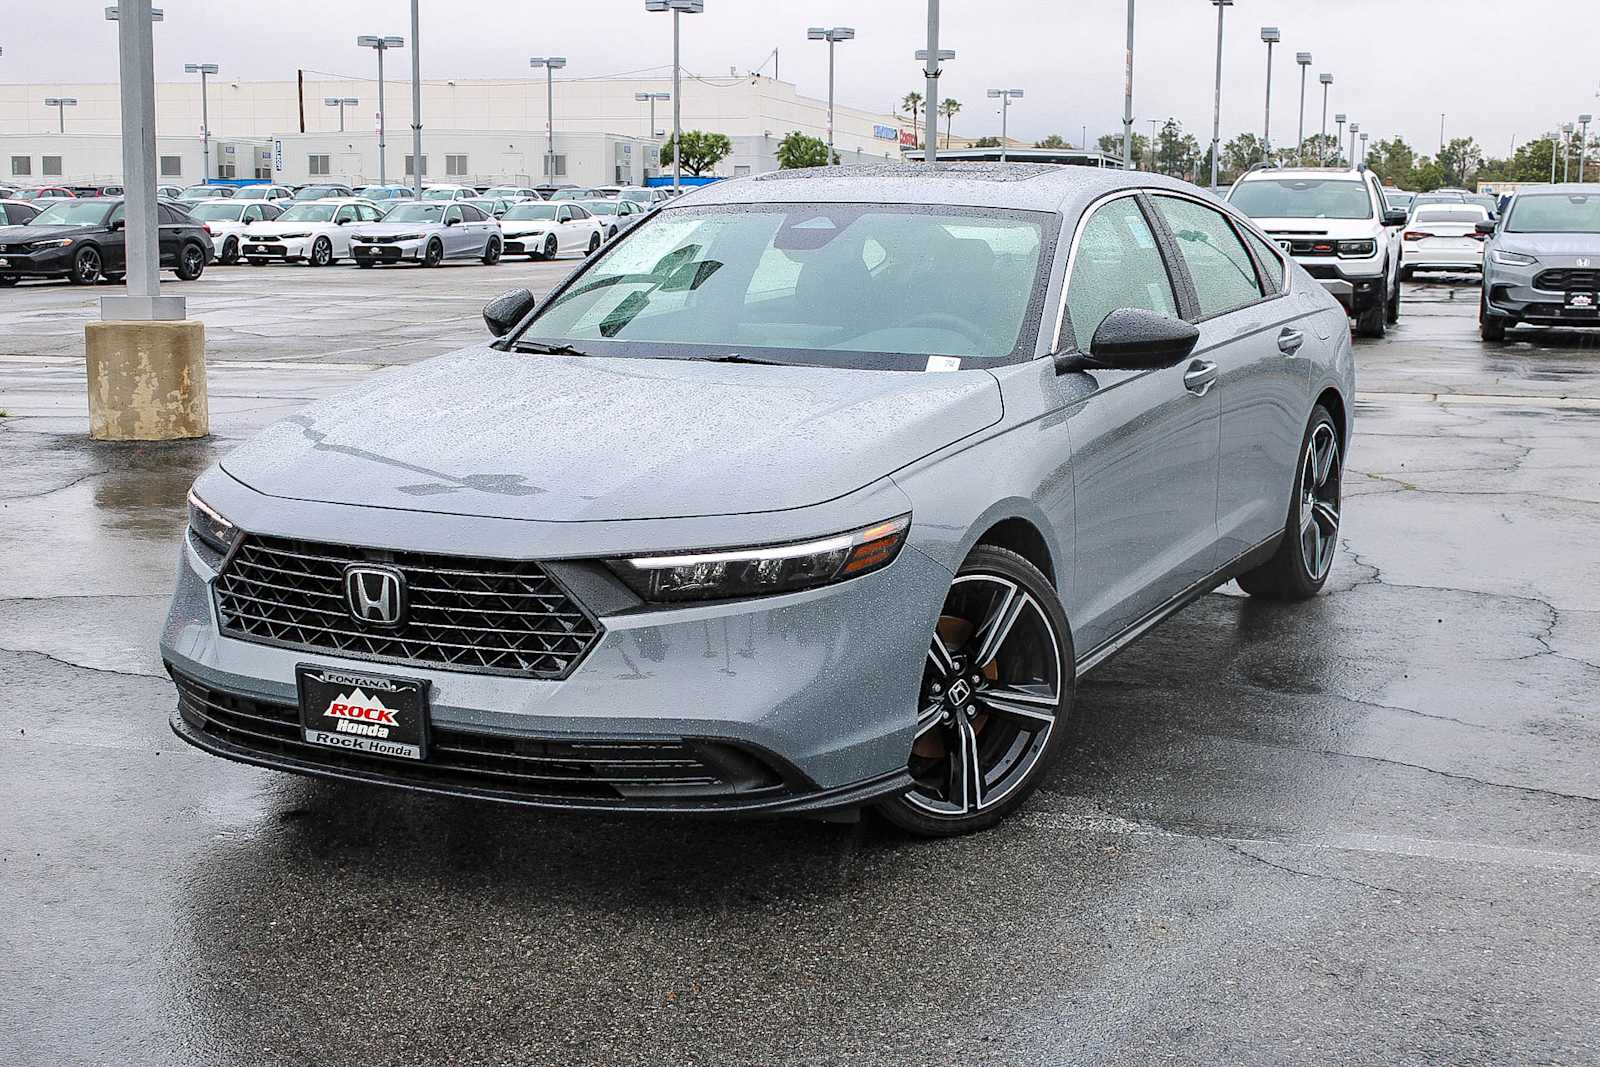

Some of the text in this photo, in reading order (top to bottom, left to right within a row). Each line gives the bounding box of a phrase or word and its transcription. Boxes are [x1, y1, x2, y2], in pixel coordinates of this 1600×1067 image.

[327, 673, 390, 689] FONTANA
[330, 703, 395, 723] ROCK
[336, 718, 390, 739] Honda
[316, 733, 412, 757] Rock Honda
